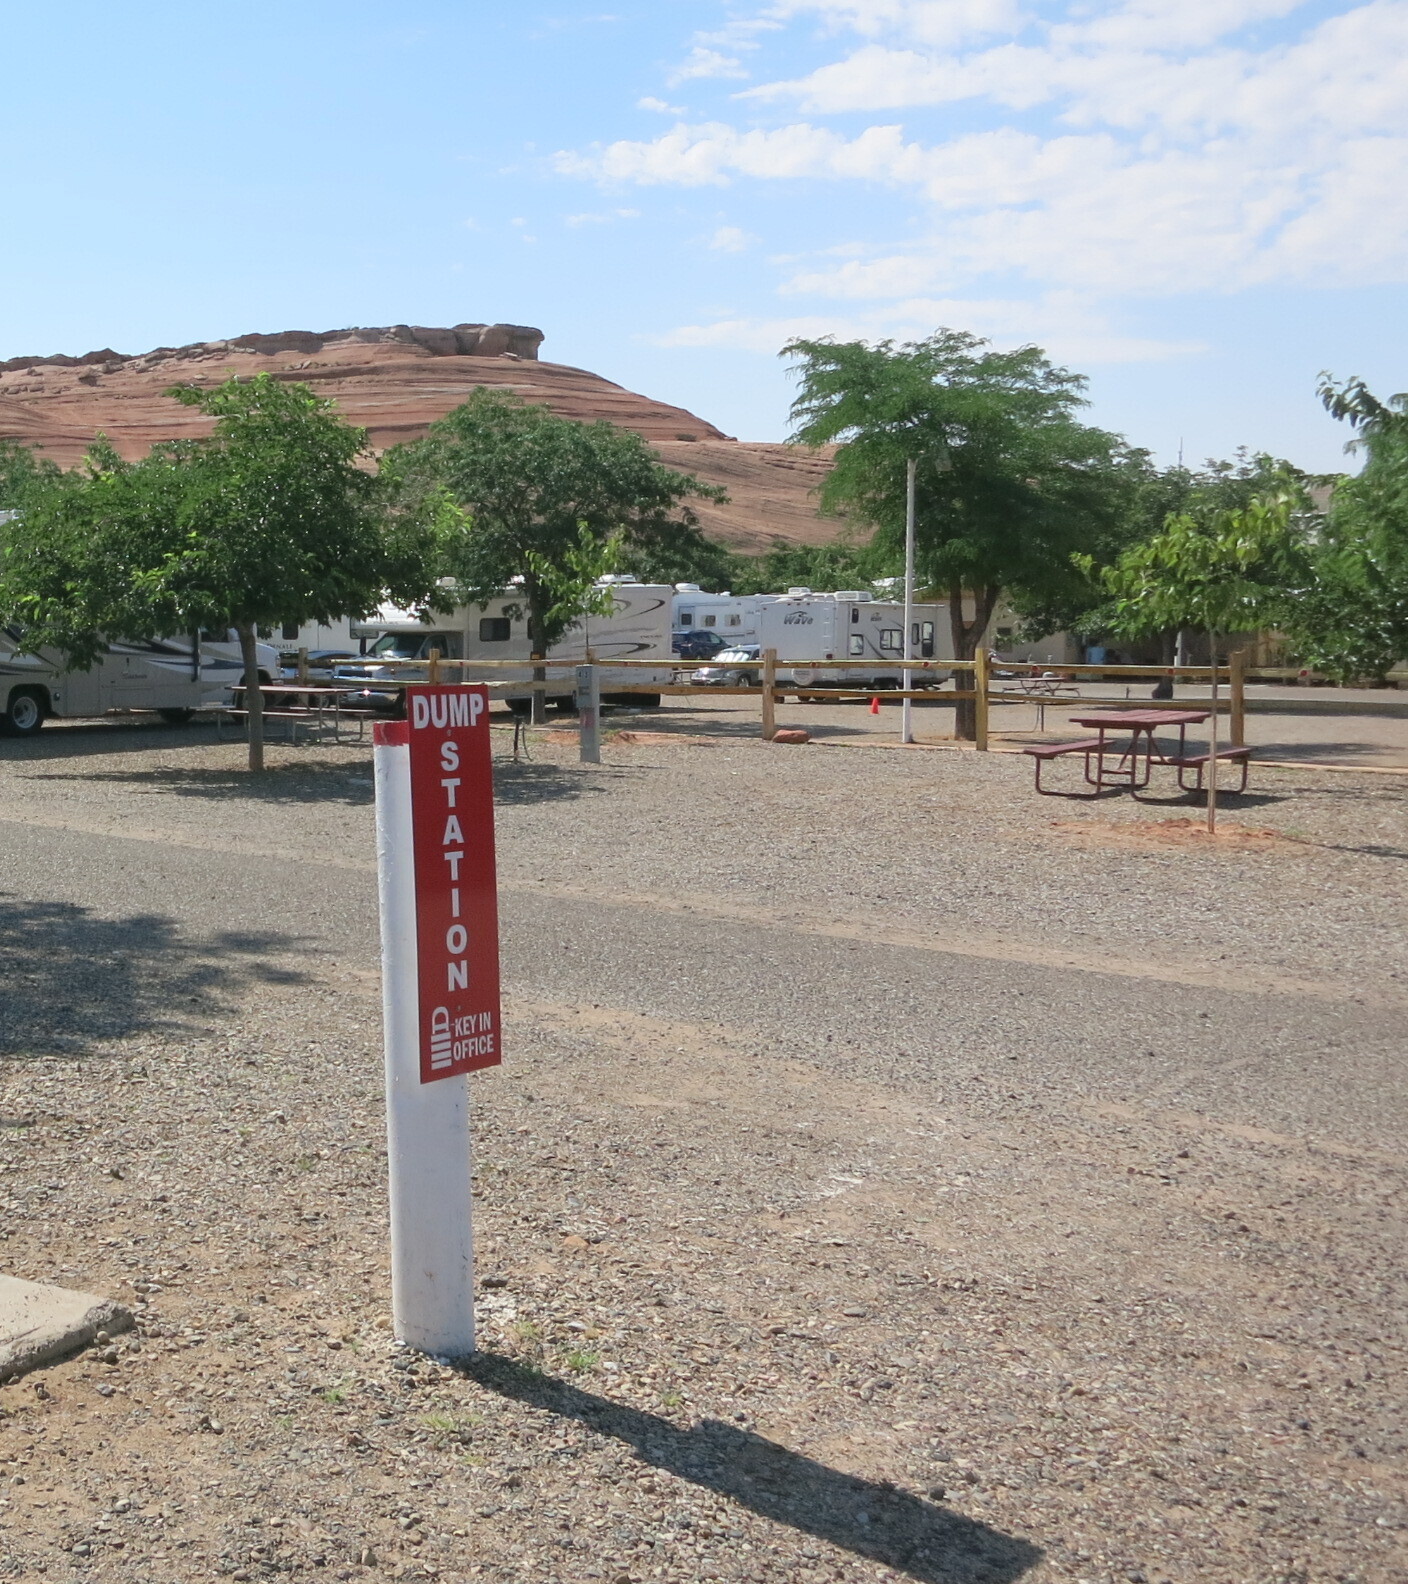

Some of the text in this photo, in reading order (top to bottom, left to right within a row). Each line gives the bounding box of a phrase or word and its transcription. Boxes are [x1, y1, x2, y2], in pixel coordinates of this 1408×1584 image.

[412, 693, 484, 730] DUMP
[440, 740, 469, 992] STATION
[454, 1011, 491, 1037] KEY IN
[453, 1033, 494, 1061] OFFICE
